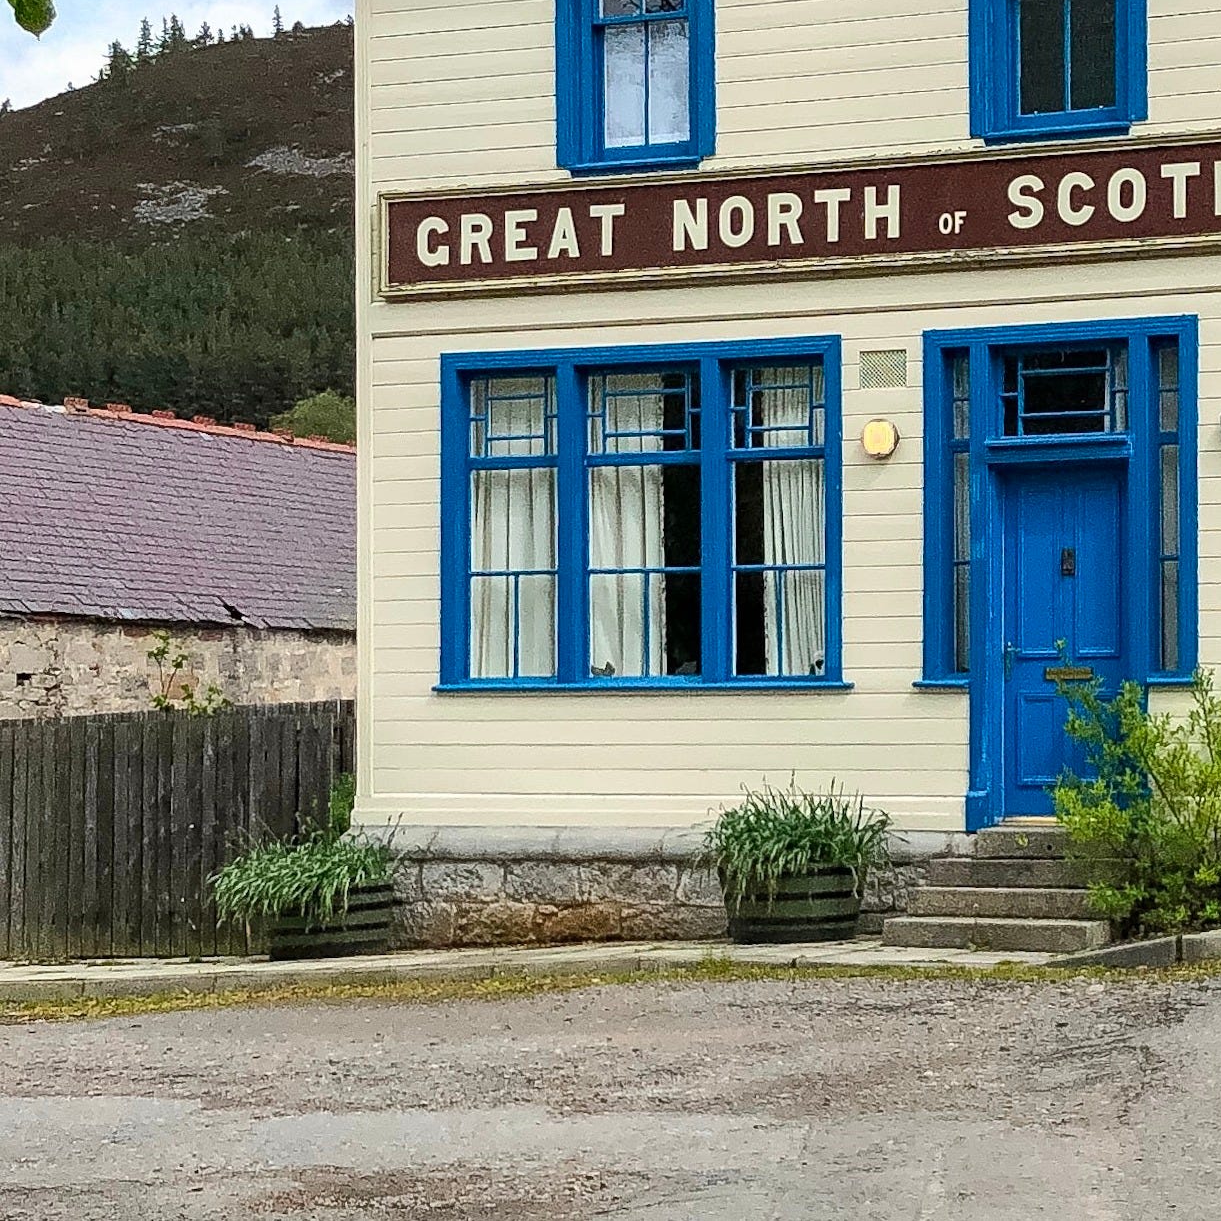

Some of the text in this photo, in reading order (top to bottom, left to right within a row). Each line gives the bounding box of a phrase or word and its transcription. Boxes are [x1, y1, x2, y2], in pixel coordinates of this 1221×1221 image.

[417, 204, 626, 267] GREAT
[672, 184, 901, 253] NORTH
[938, 210, 968, 235] OF
